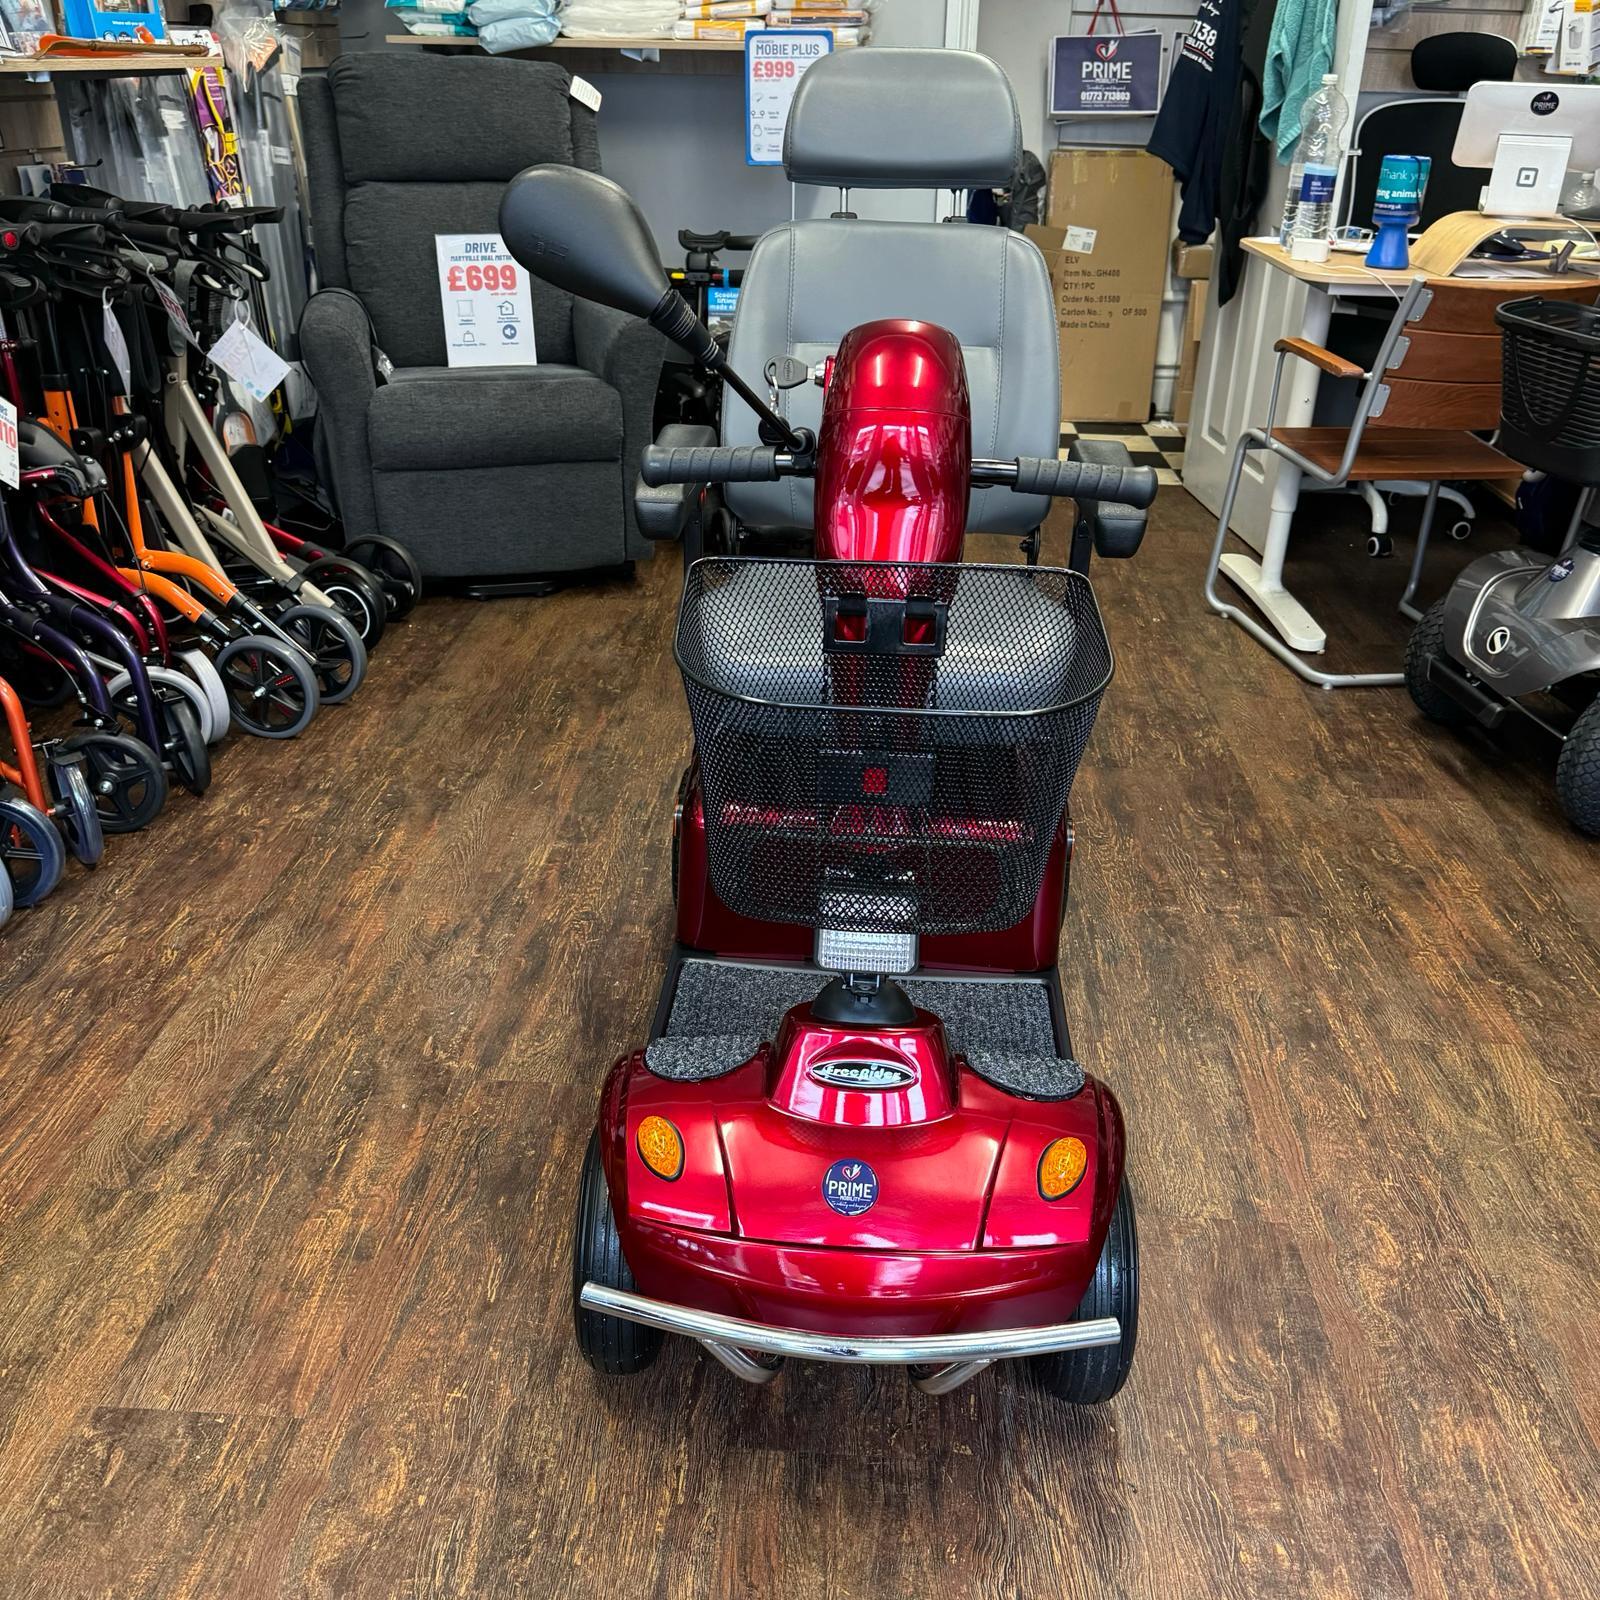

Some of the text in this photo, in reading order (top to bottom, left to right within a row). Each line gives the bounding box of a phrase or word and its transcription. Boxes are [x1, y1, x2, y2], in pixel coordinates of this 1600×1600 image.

[756, 43, 820, 55] MOBIE PLUS
[753, 60, 795, 78] £999
[1081, 61, 1133, 79] PRIME
[1383, 168, 1408, 180] Thank
[465, 242, 497, 254] DRIVE
[1064, 256, 1080, 264] ELV
[447, 264, 517, 292] £699
[1063, 269, 1080, 277] Item
[1062, 295, 1084, 303] Order
[1060, 308, 1086, 316] Carton
[1060, 320, 1079, 328] Made
[1088, 320, 1110, 329] China
[828, 1180, 873, 1199] PRIME
